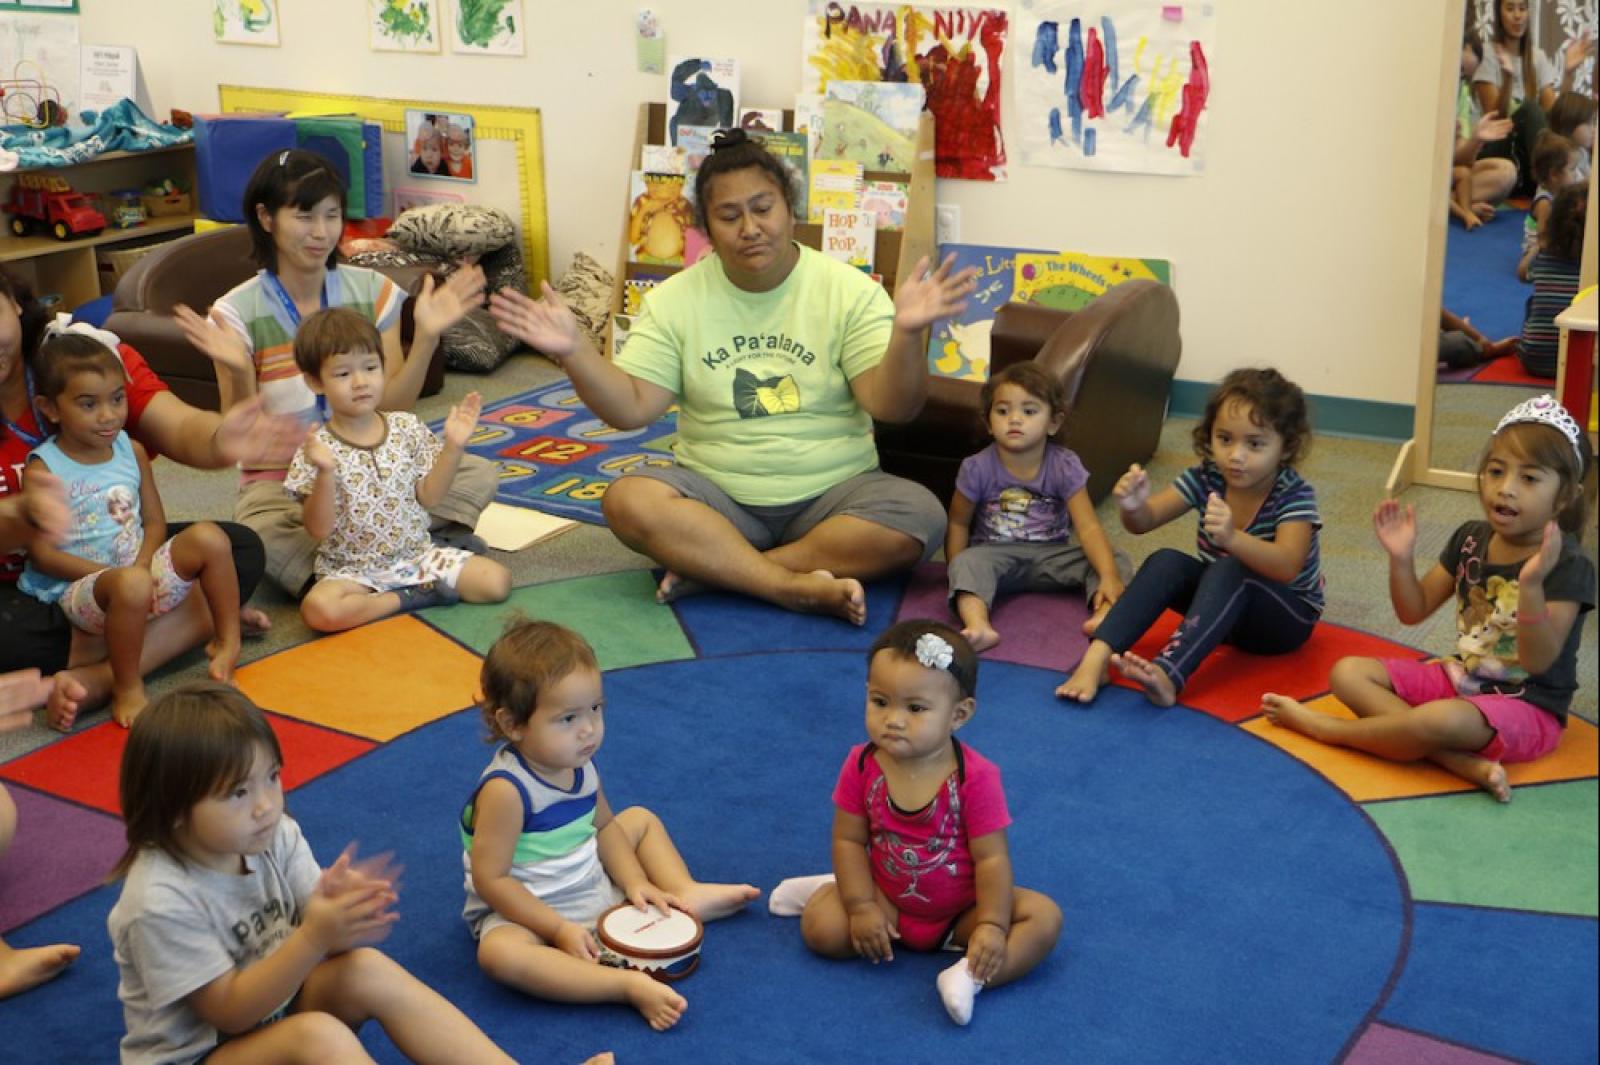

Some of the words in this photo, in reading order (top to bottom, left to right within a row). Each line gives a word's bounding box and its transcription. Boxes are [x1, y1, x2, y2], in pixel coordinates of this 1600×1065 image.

[829, 213, 857, 228] HOP
[1044, 260, 1066, 272] The
[702, 347, 730, 370] Ka
[500, 409, 547, 425] 6
[519, 440, 588, 460] 12
[543, 477, 608, 499] 18
